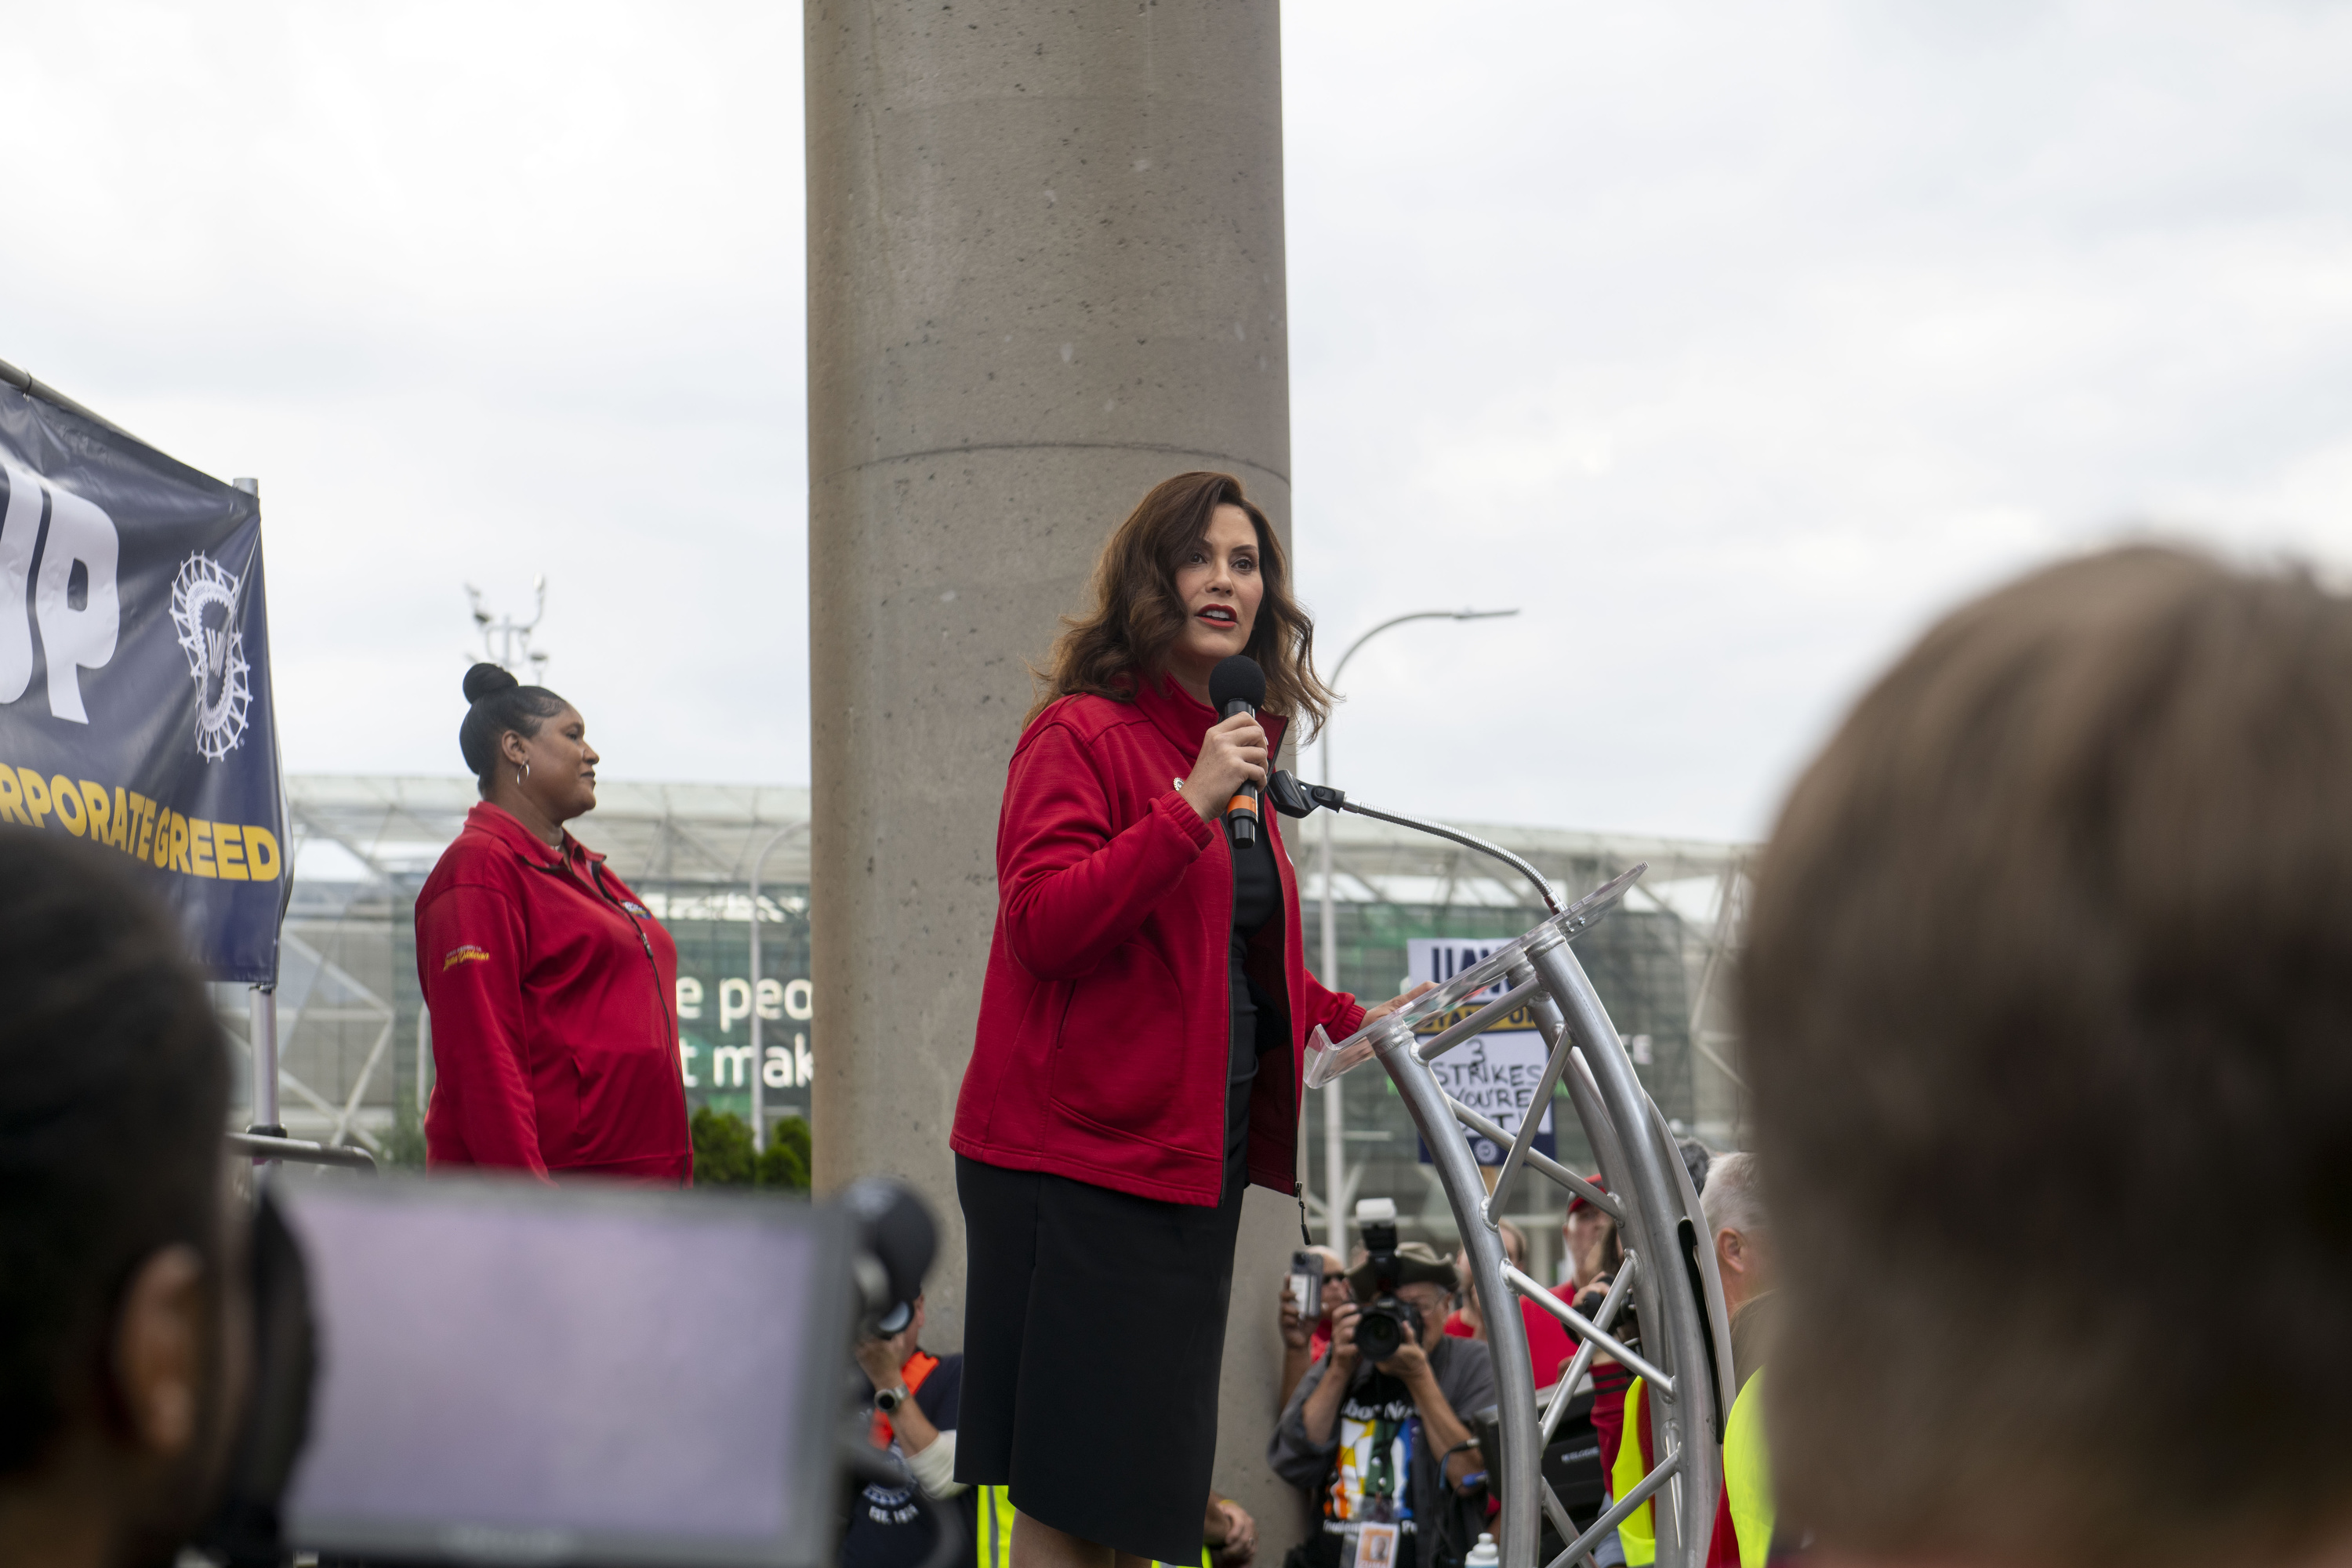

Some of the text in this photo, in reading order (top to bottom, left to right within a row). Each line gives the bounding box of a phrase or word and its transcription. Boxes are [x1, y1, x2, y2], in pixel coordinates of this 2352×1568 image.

[154, 807, 281, 882] GREED
[720, 978, 813, 1033] peo
[1465, 1038, 1486, 1064] 3
[1429, 1062, 1542, 1087] STRIKES
[1446, 1087, 1531, 1109] YOU'RE
